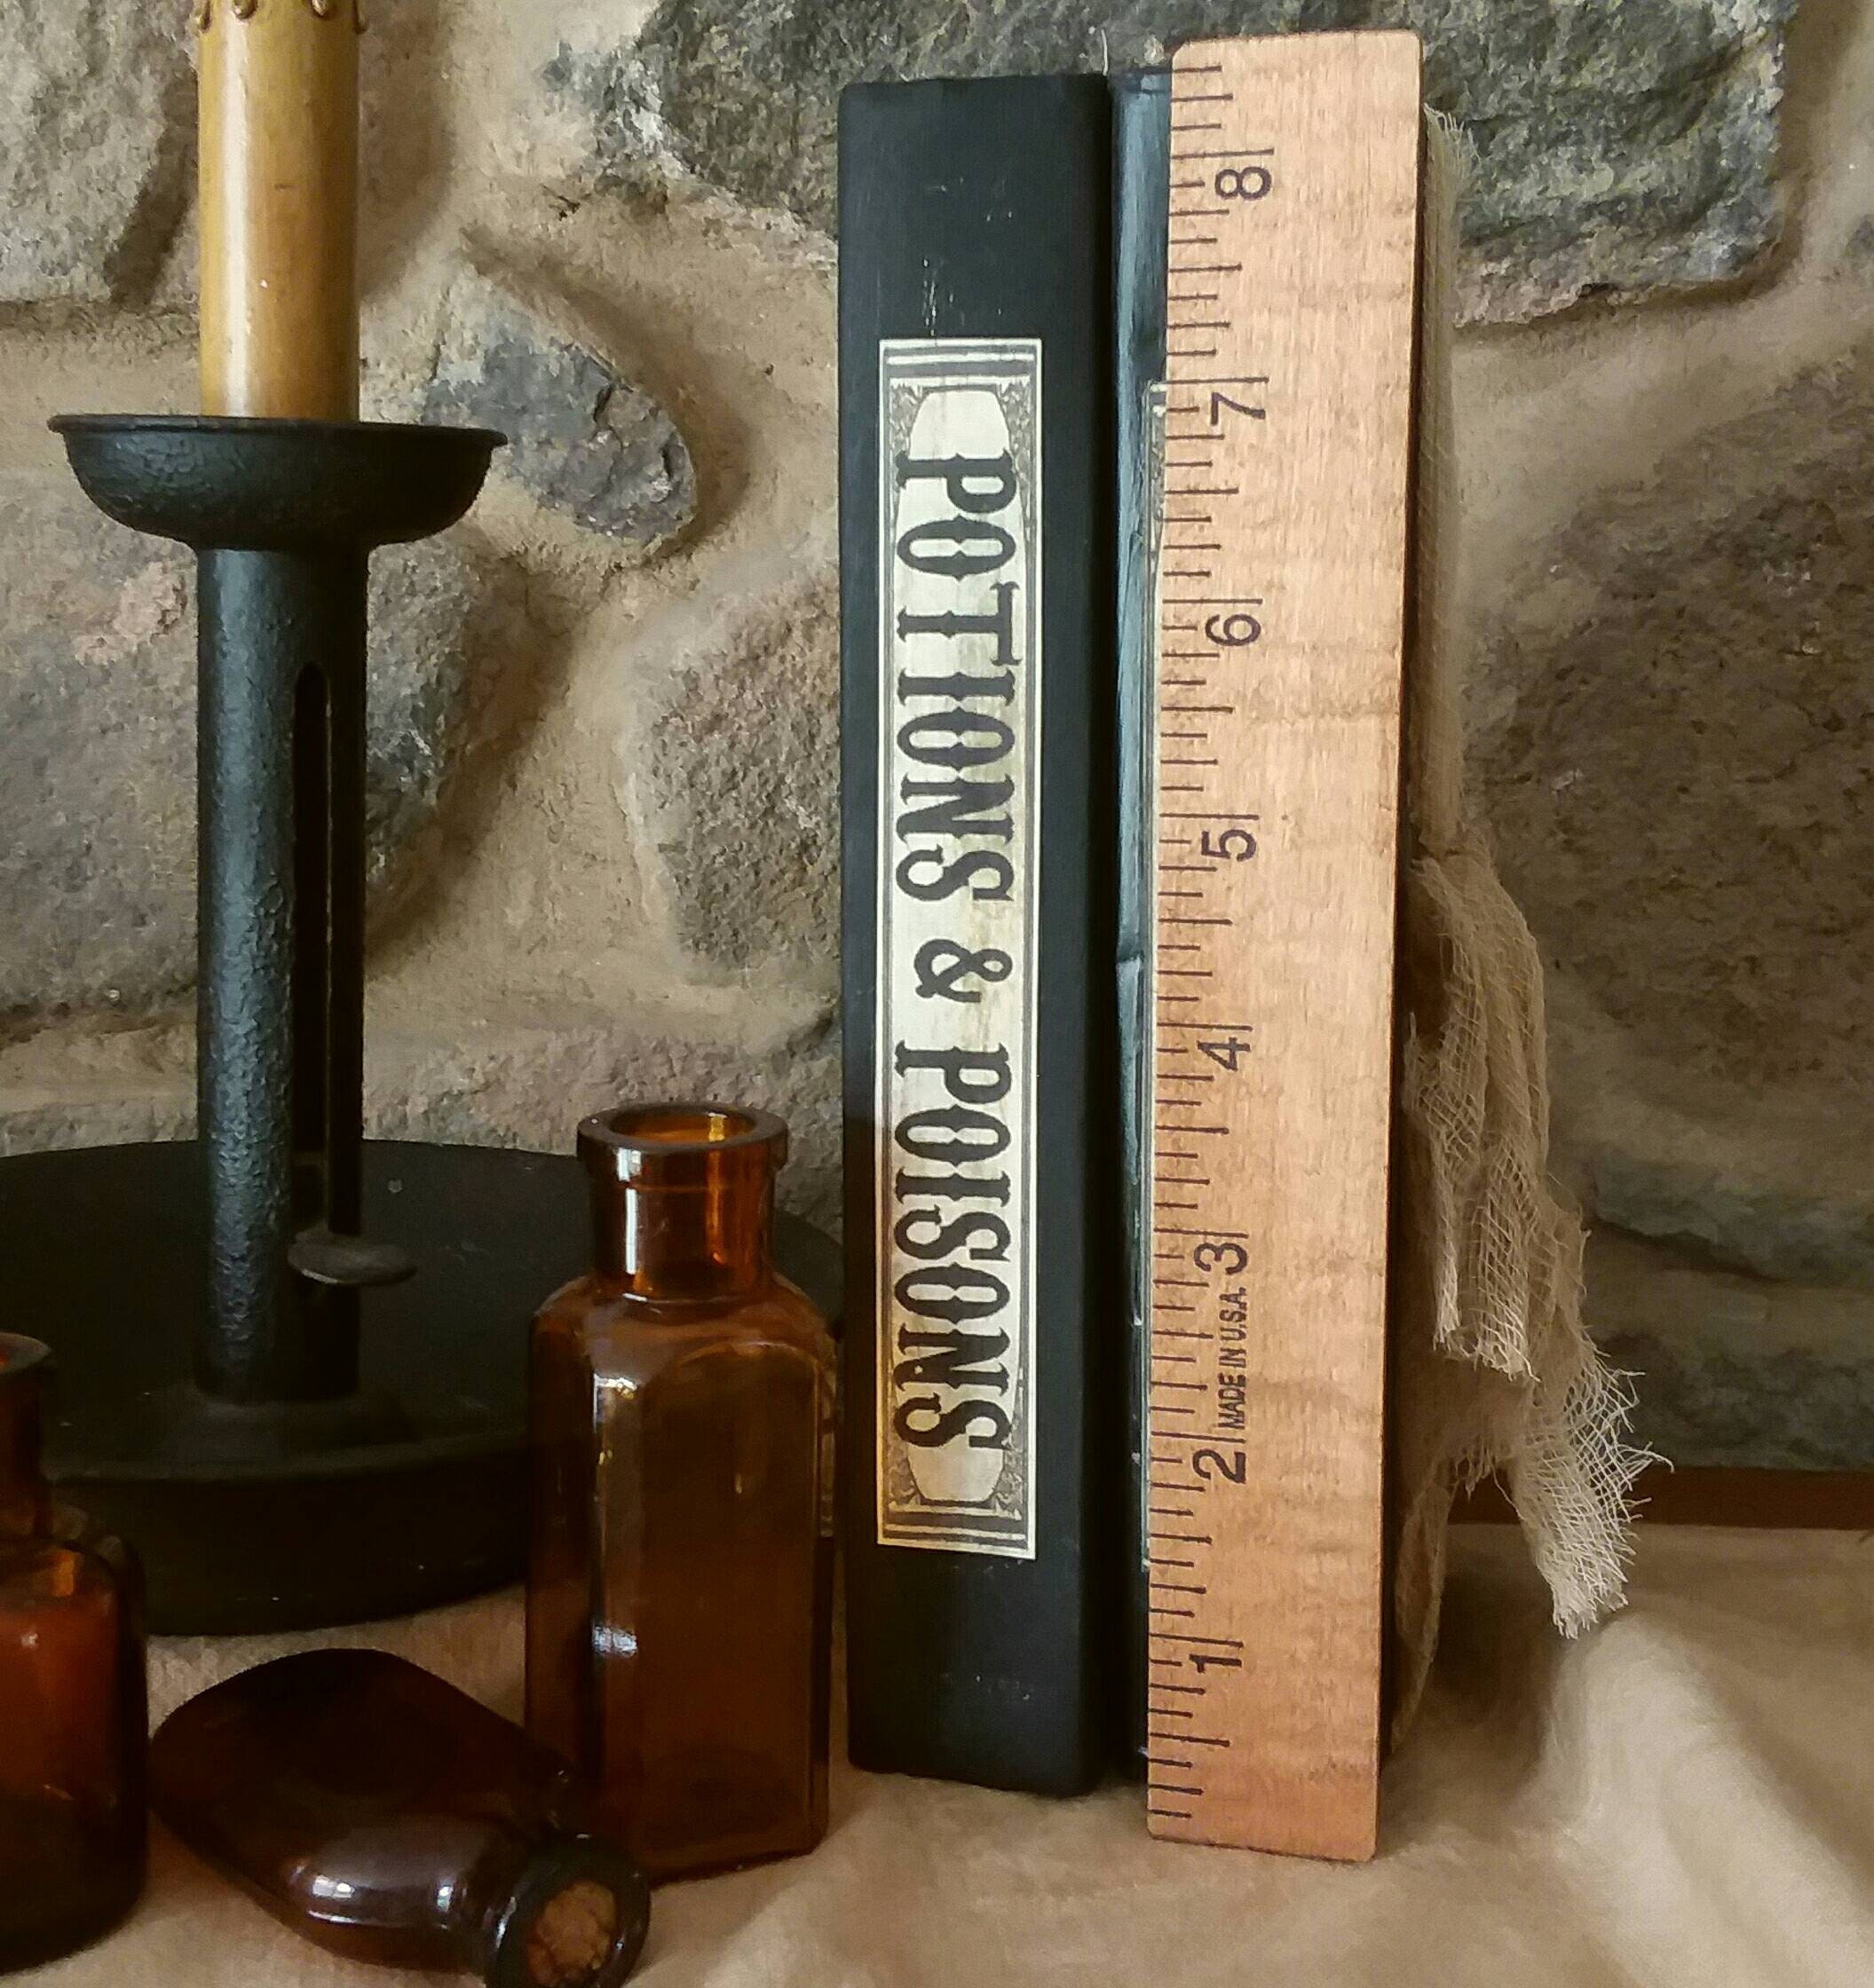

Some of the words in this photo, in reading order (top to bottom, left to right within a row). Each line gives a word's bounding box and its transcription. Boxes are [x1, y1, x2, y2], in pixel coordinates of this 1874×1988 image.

[1214, 165, 1271, 201] 8
[1209, 391, 1266, 425] 7
[1205, 613, 1261, 647] 6
[896, 448, 1021, 903] POTIONS
[1200, 828, 1257, 863] 5
[913, 938, 1014, 1004] &
[1198, 1036, 1251, 1071] 4
[893, 1039, 1013, 1452] POISONS
[1193, 1242, 1249, 1276] 3
[1218, 1346, 1247, 1370] IN
[1217, 1373, 1247, 1432] MADE
[1192, 1448, 1247, 1485] 2
[1189, 1653, 1243, 1674] 1
